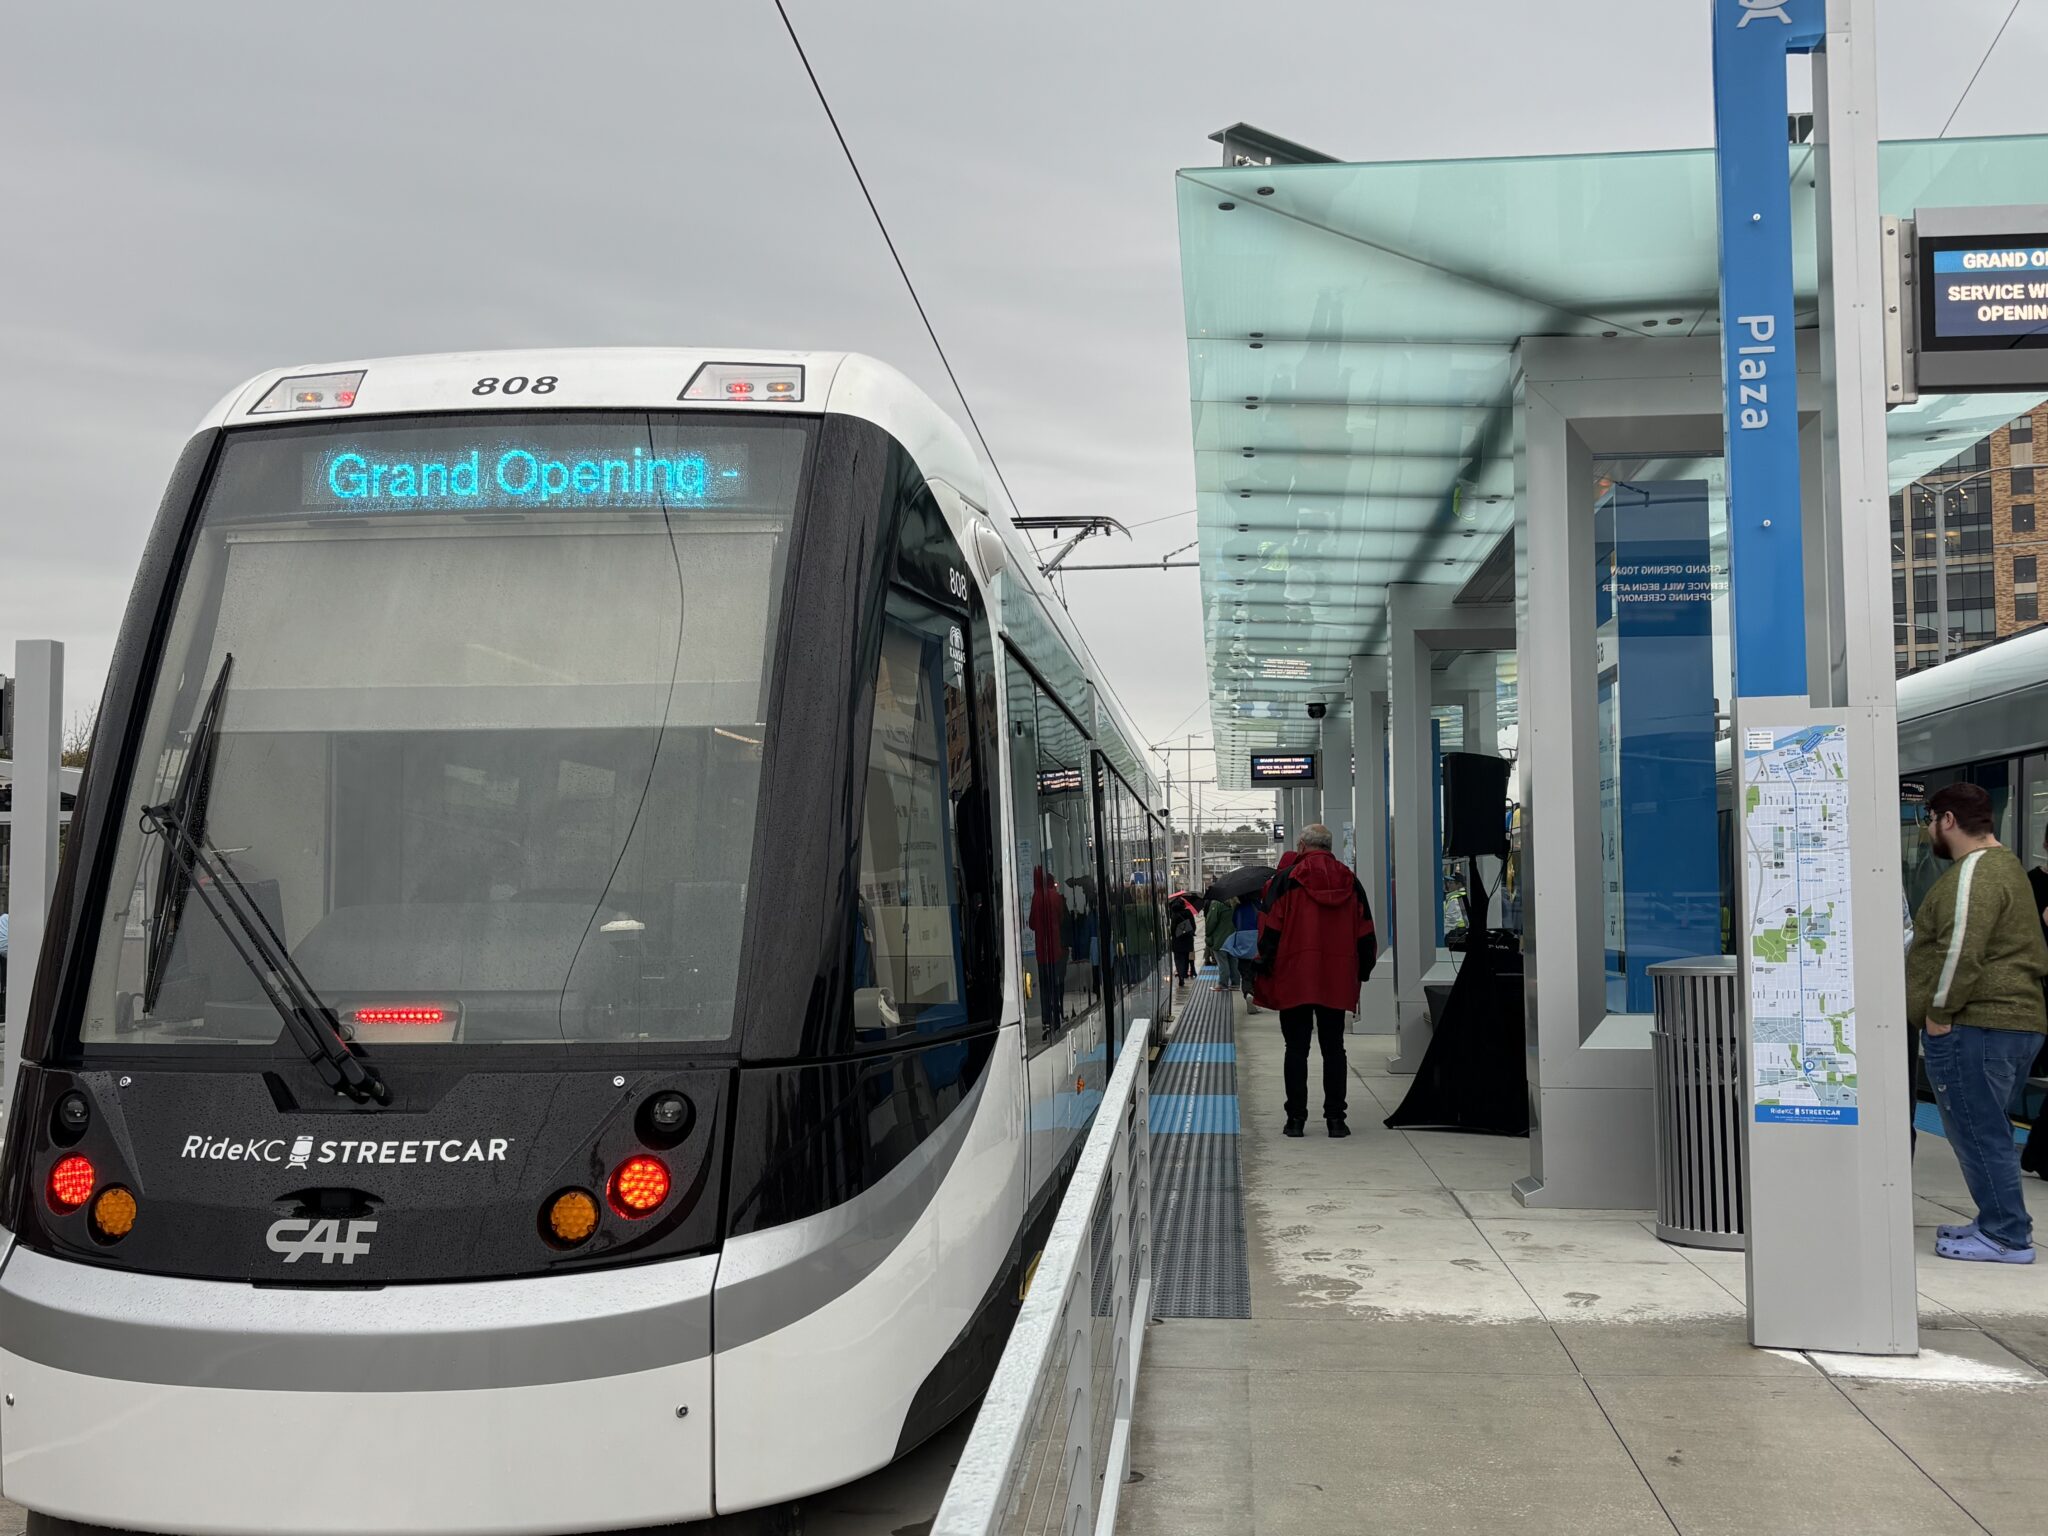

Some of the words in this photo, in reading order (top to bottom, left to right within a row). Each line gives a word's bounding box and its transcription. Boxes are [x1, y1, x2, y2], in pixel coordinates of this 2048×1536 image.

[1963, 252, 2027, 268] GRAND
[1948, 284, 2024, 301] SERVICE
[1977, 304, 2048, 321] OPENIN
[1737, 315, 1776, 430] Plaza
[472, 376, 558, 395] 808
[328, 450, 479, 498] Grand
[496, 447, 705, 501] Opening
[949, 567, 967, 601] 808
[1801, 1108, 1841, 1116] STREETCAR
[181, 1135, 286, 1162] RideKC
[317, 1138, 508, 1163] STREETCAR
[265, 1219, 378, 1264] CAF
